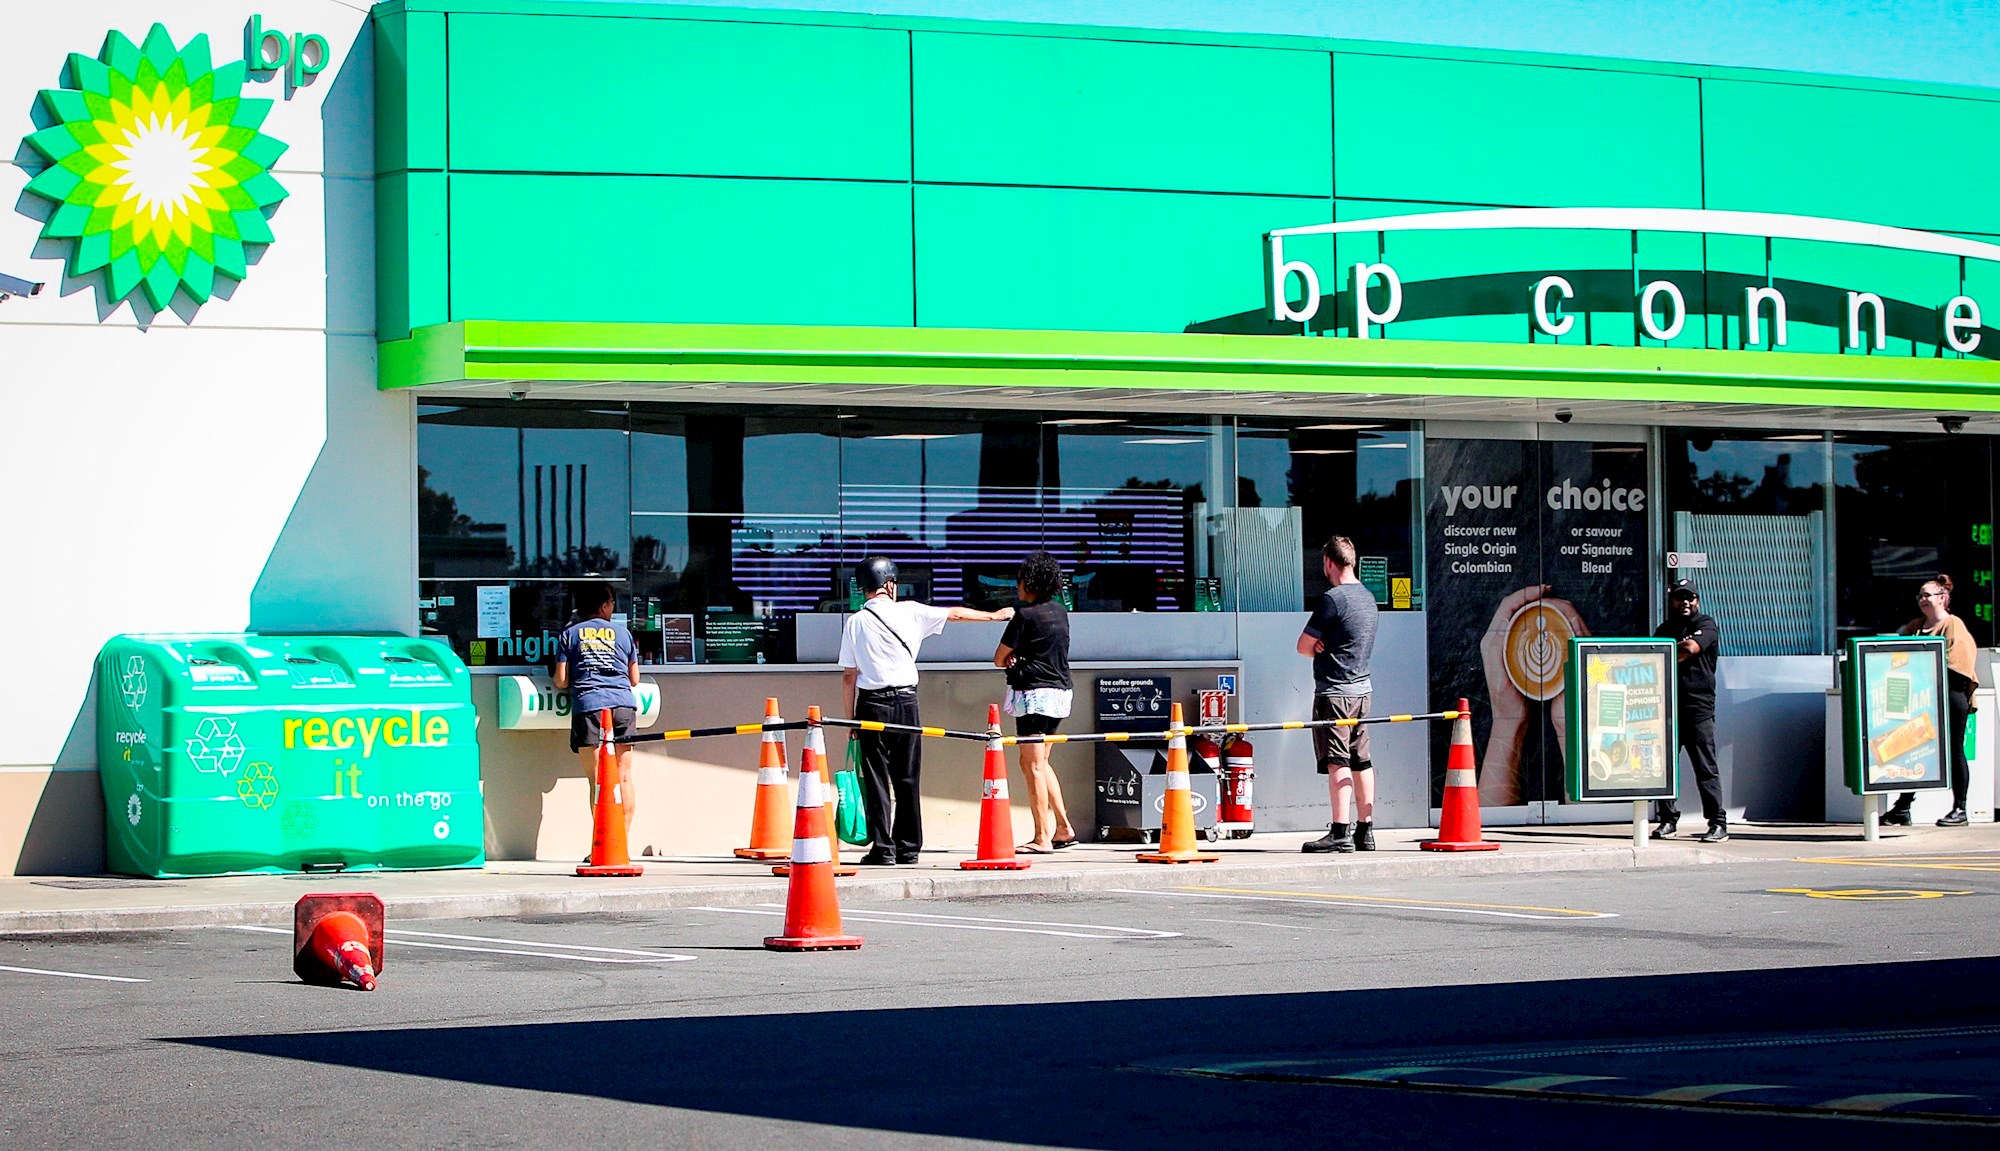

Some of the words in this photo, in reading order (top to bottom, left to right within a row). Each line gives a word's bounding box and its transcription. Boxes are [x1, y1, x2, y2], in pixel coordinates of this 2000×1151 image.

[250, 14, 330, 88] bp
[1271, 235, 1403, 339] bp
[1533, 275, 1983, 353] conne
[1441, 485, 1517, 516] your
[1547, 478, 1645, 511] choice
[1444, 525, 1490, 536] discover
[1493, 527, 1517, 536] new
[1571, 528, 1583, 536] or
[1585, 528, 1622, 537] savour
[1444, 543, 1479, 557] Single
[1482, 543, 1517, 557] Origin
[1560, 546, 1579, 555] our
[1581, 543, 1633, 557] Signature
[1451, 561, 1512, 573] Colombian
[1582, 561, 1612, 573] Blend
[579, 627, 616, 641] UB40
[498, 629, 559, 662] nigh
[1130, 679, 1154, 687] grounds
[1615, 665, 1654, 686] WIN
[529, 687, 572, 717] nig
[1626, 696, 1660, 705] ADPHONES
[1626, 707, 1655, 720] DAILY
[116, 729, 147, 747] recycle
[283, 710, 451, 759] recycle
[123, 746, 132, 762] it
[334, 758, 364, 799] it
[367, 794, 390, 808] on
[395, 791, 425, 807] the
[430, 793, 453, 811] go
